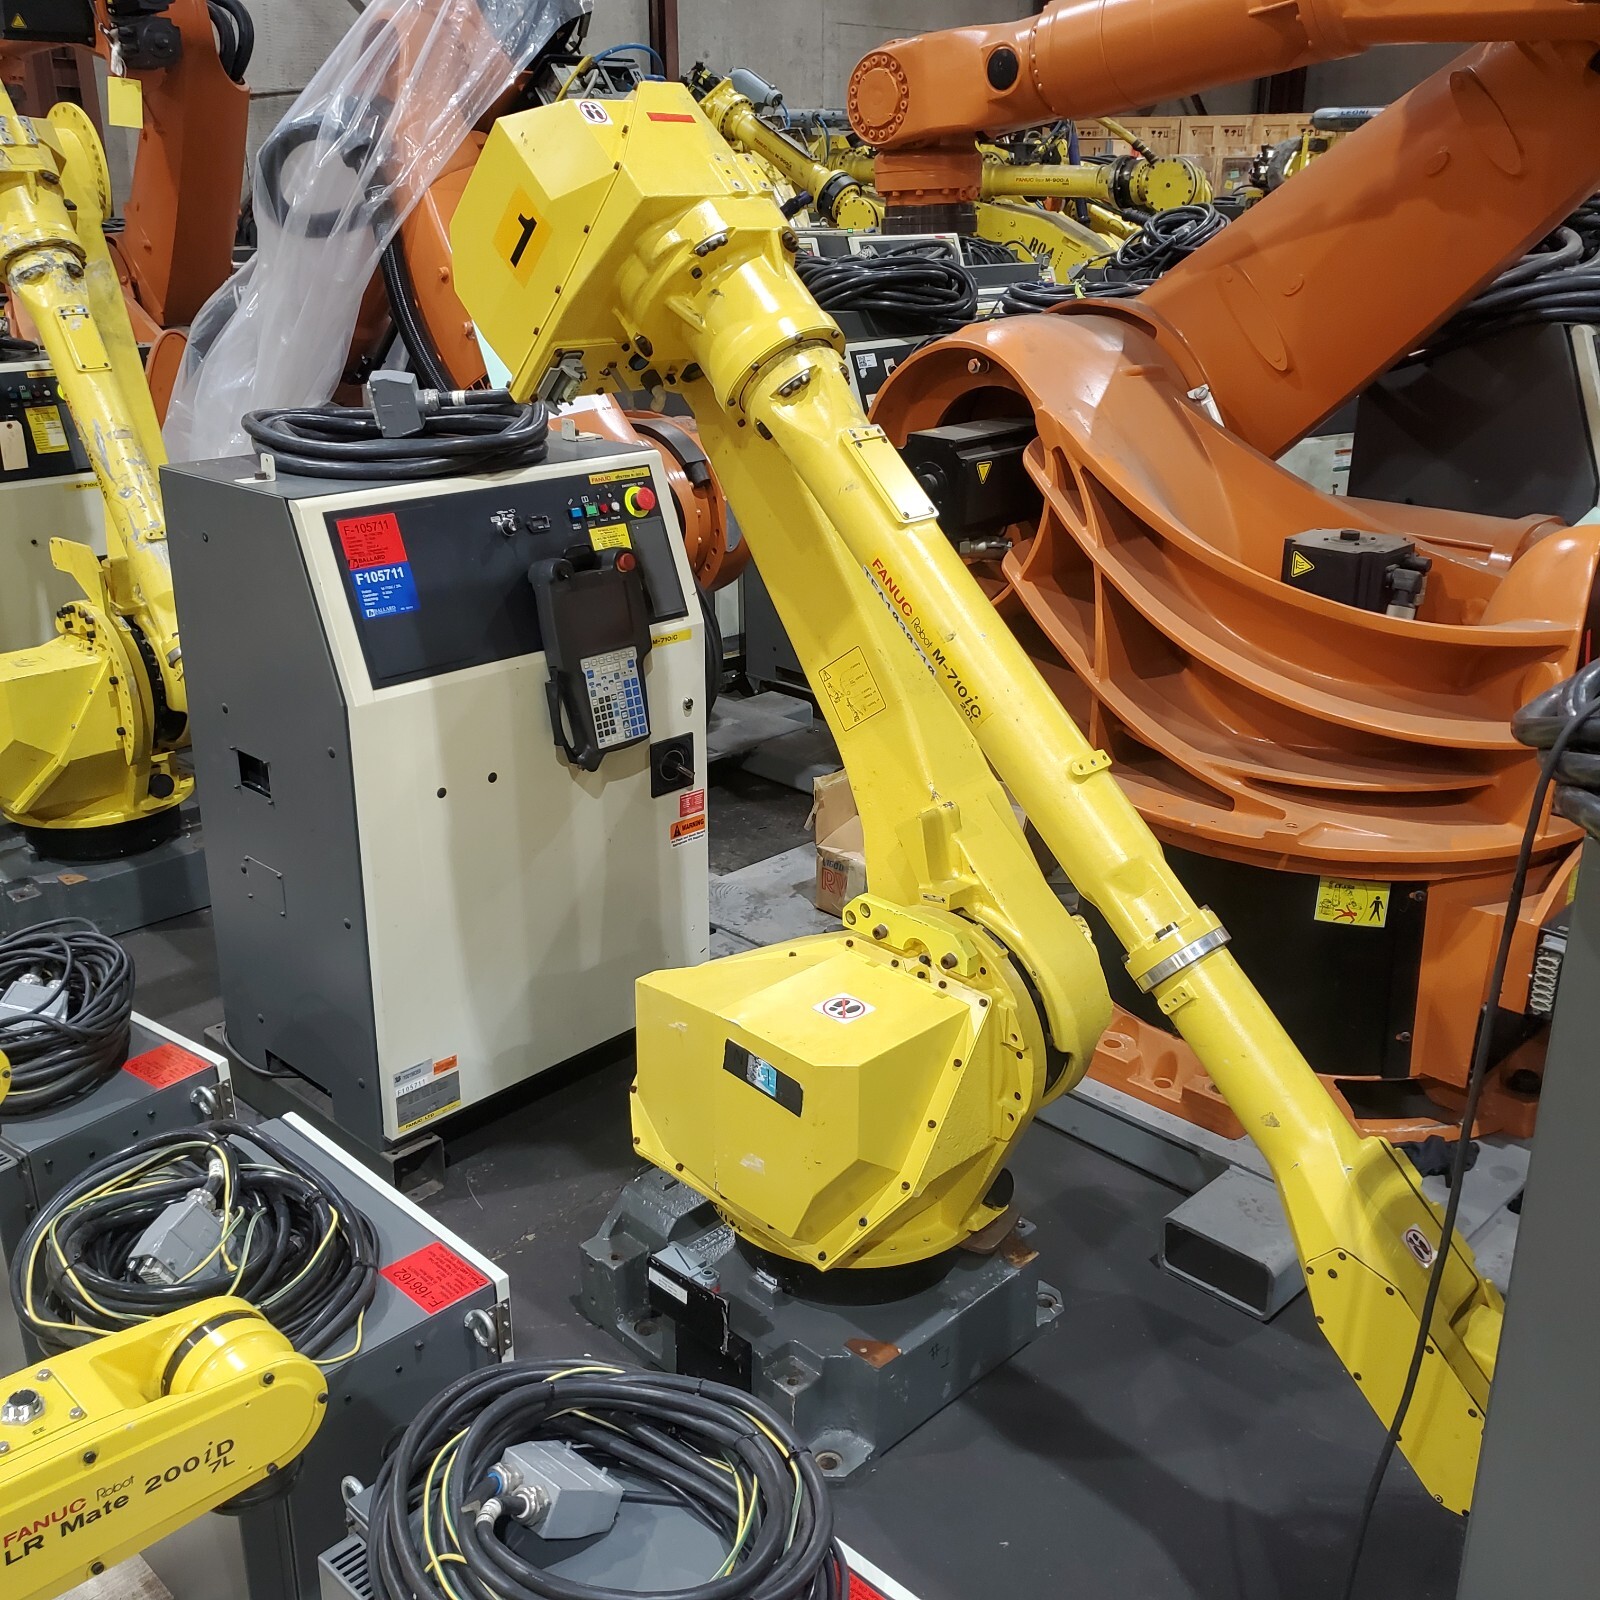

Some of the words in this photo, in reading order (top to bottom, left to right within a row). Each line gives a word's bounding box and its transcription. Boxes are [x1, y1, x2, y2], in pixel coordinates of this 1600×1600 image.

[509, 212, 538, 268] 1
[591, 475, 611, 484] FANUC
[343, 519, 389, 536] F-105711
[355, 566, 405, 586] F105711
[872, 558, 913, 617] FANUC
[911, 616, 933, 649] Robot
[959, 702, 975, 724] 20L
[681, 818, 705, 831] WARNING
[397, 1078, 426, 1096] F105711
[405, 1118, 422, 1129] FANUC
[393, 1267, 444, 1308] F-166162
[208, 1456, 236, 1474] 7L
[3, 1497, 87, 1549] FANUC
[96, 1475, 136, 1501] Robot
[4, 1534, 45, 1566] LR
[60, 1494, 130, 1538] Mate
[144, 1438, 235, 1496] 200iD
